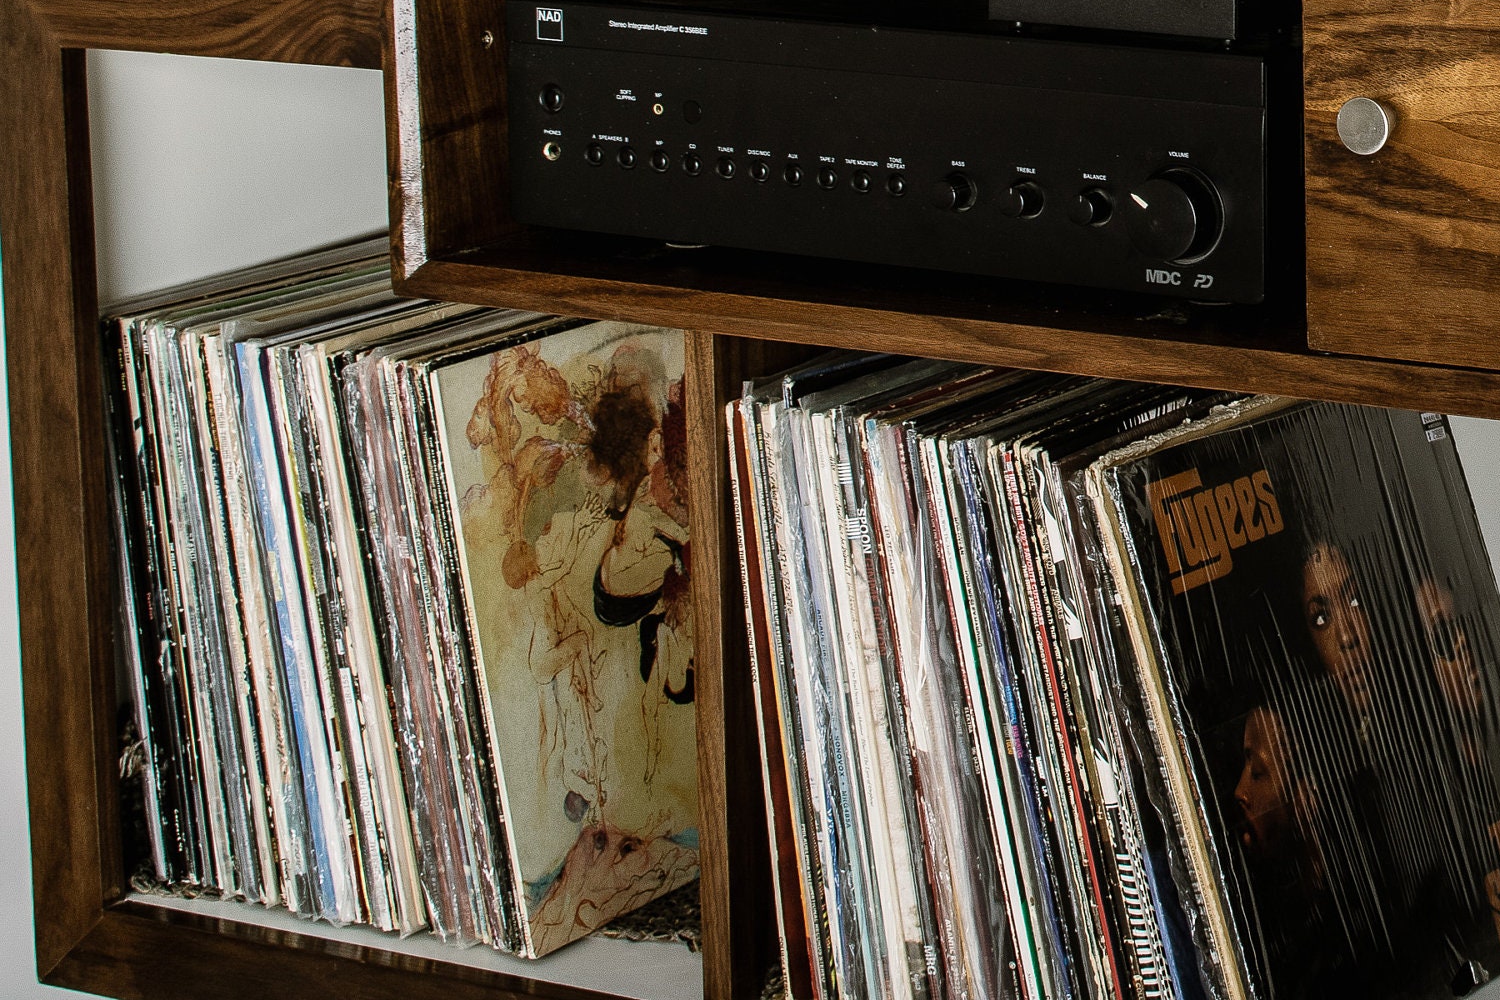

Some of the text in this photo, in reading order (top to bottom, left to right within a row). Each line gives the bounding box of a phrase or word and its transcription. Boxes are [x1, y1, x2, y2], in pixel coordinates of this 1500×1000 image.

[537, 10, 561, 22] NAD
[609, 20, 627, 29] Stereo
[627, 21, 655, 31] Integrated
[655, 23, 679, 33] Amplifier
[598, 134, 623, 142] SPEAKERS
[886, 162, 905, 170] DEFEAT
[1016, 166, 1036, 174] TREBLE
[1168, 151, 1189, 159] VOLUME
[1083, 173, 1107, 181] BALANCE
[1146, 269, 1181, 286] MDC
[730, 478, 738, 497] ELVIS
[732, 498, 742, 534] COSTELLO
[1146, 466, 1284, 595] Fugees
[854, 507, 872, 555] SPOON
[863, 556, 880, 602] GIMME
[1014, 504, 1023, 522] MISTY
[1022, 548, 1036, 584] FAVORITE
[1030, 584, 1045, 626] CUSTOMER
[739, 564, 749, 609] ATTRACTIONS
[1021, 564, 1039, 629] THE RISE AND FALL
[1050, 587, 1064, 621] ANIMALS
[745, 622, 757, 683] PUNCH THE CLOCK
[1040, 663, 1060, 732] STARDUST AND THE
[953, 714, 963, 736] WHITE
[963, 706, 973, 734] ELEKTRA
[833, 735, 845, 777] SONOVOX
[355, 762, 375, 834] JOHN COLTRANE
[923, 944, 937, 976] MRG
